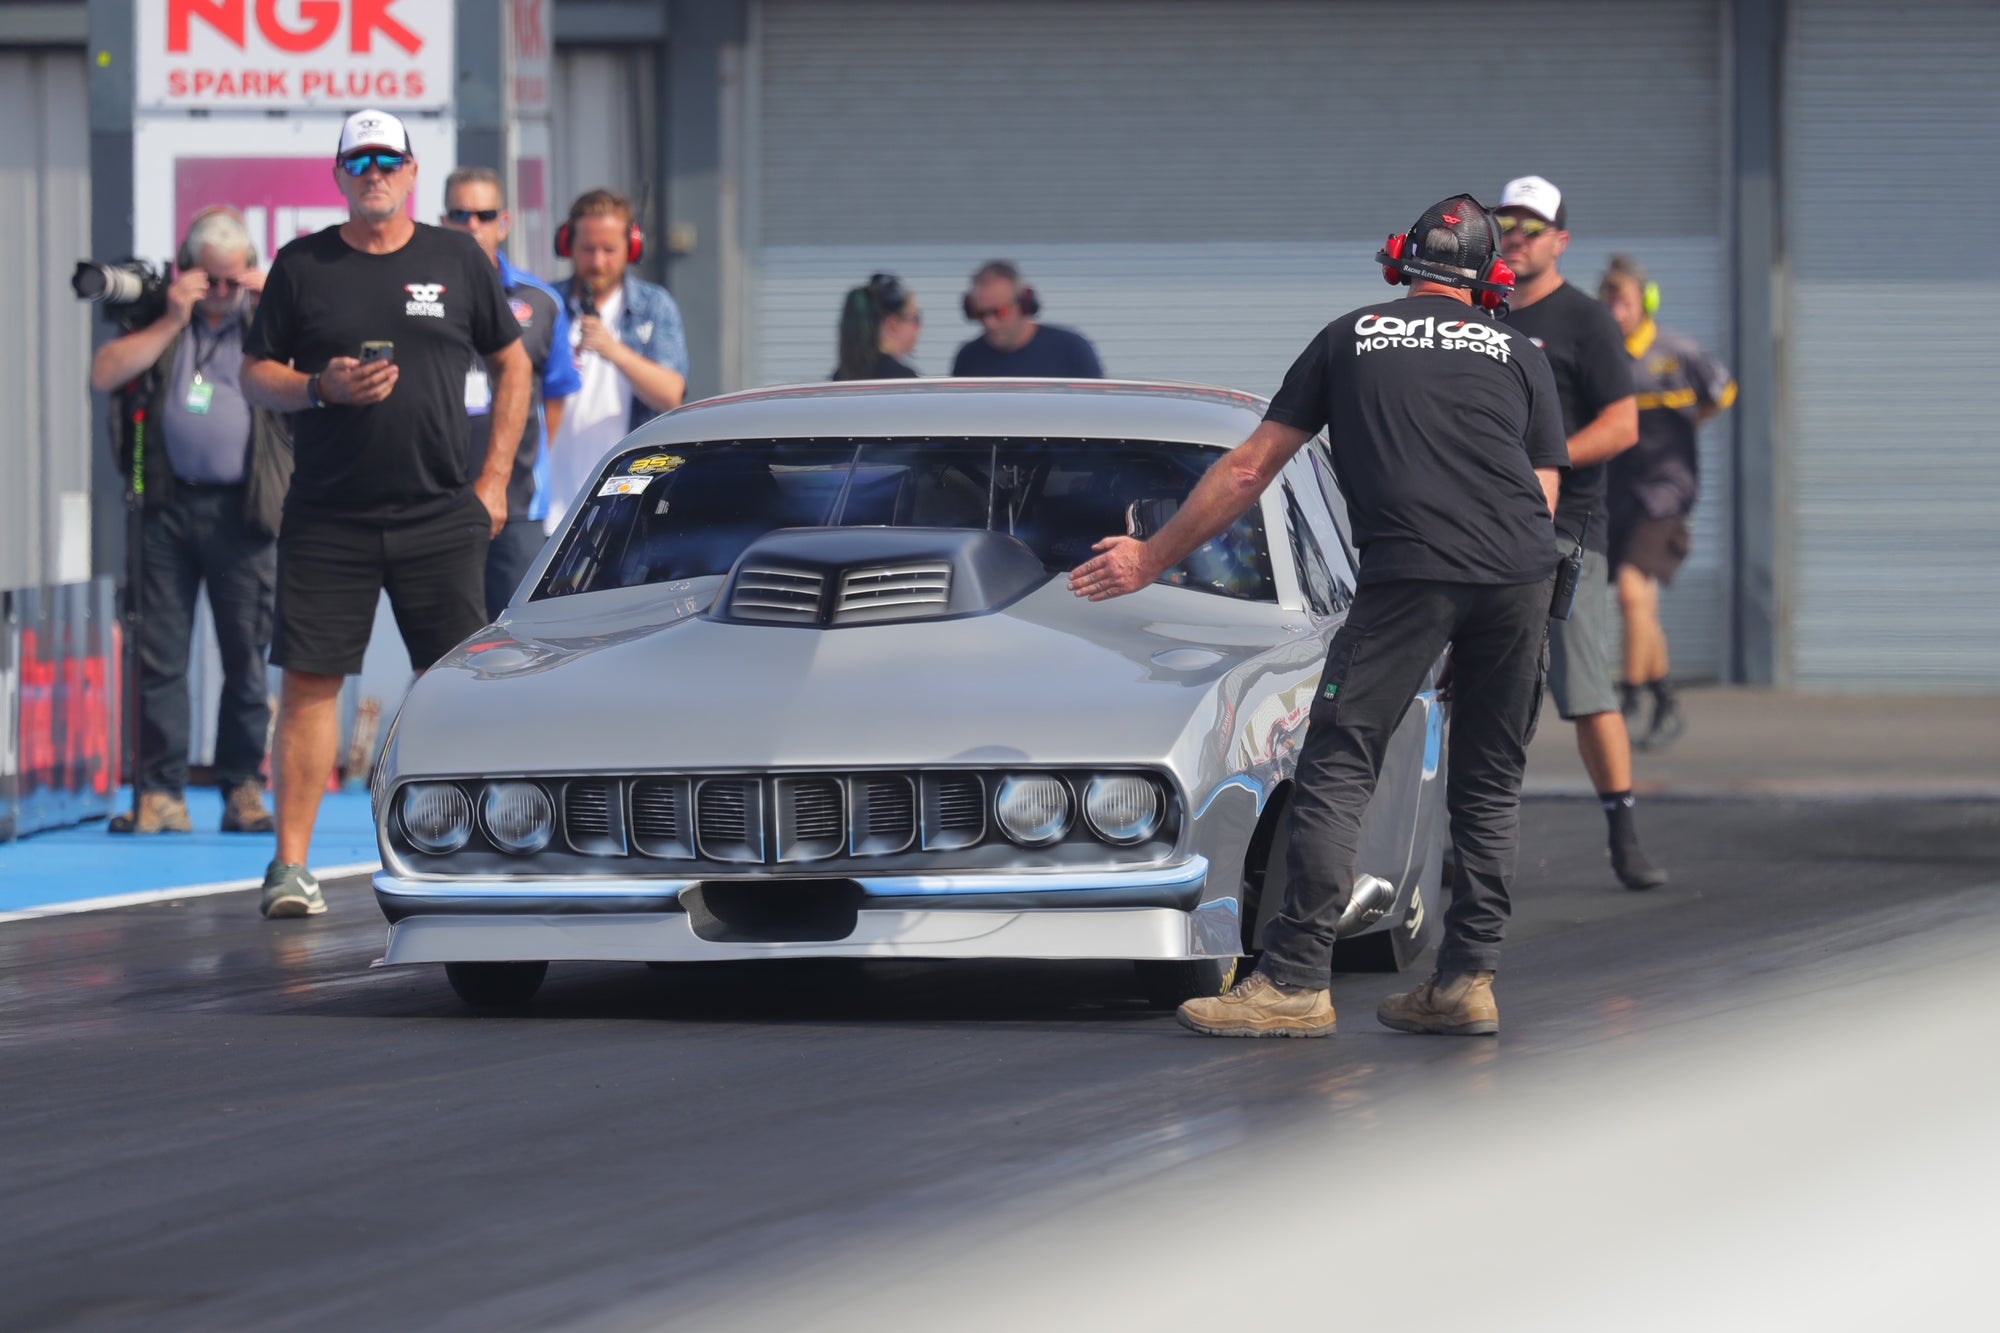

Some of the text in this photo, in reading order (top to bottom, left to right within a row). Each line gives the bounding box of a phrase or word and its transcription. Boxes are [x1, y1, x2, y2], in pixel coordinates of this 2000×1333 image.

[167, 0, 423, 55] NGK
[169, 71, 425, 98] SPARK PLUGS
[1356, 336, 1511, 363] MOTOR SPORT
